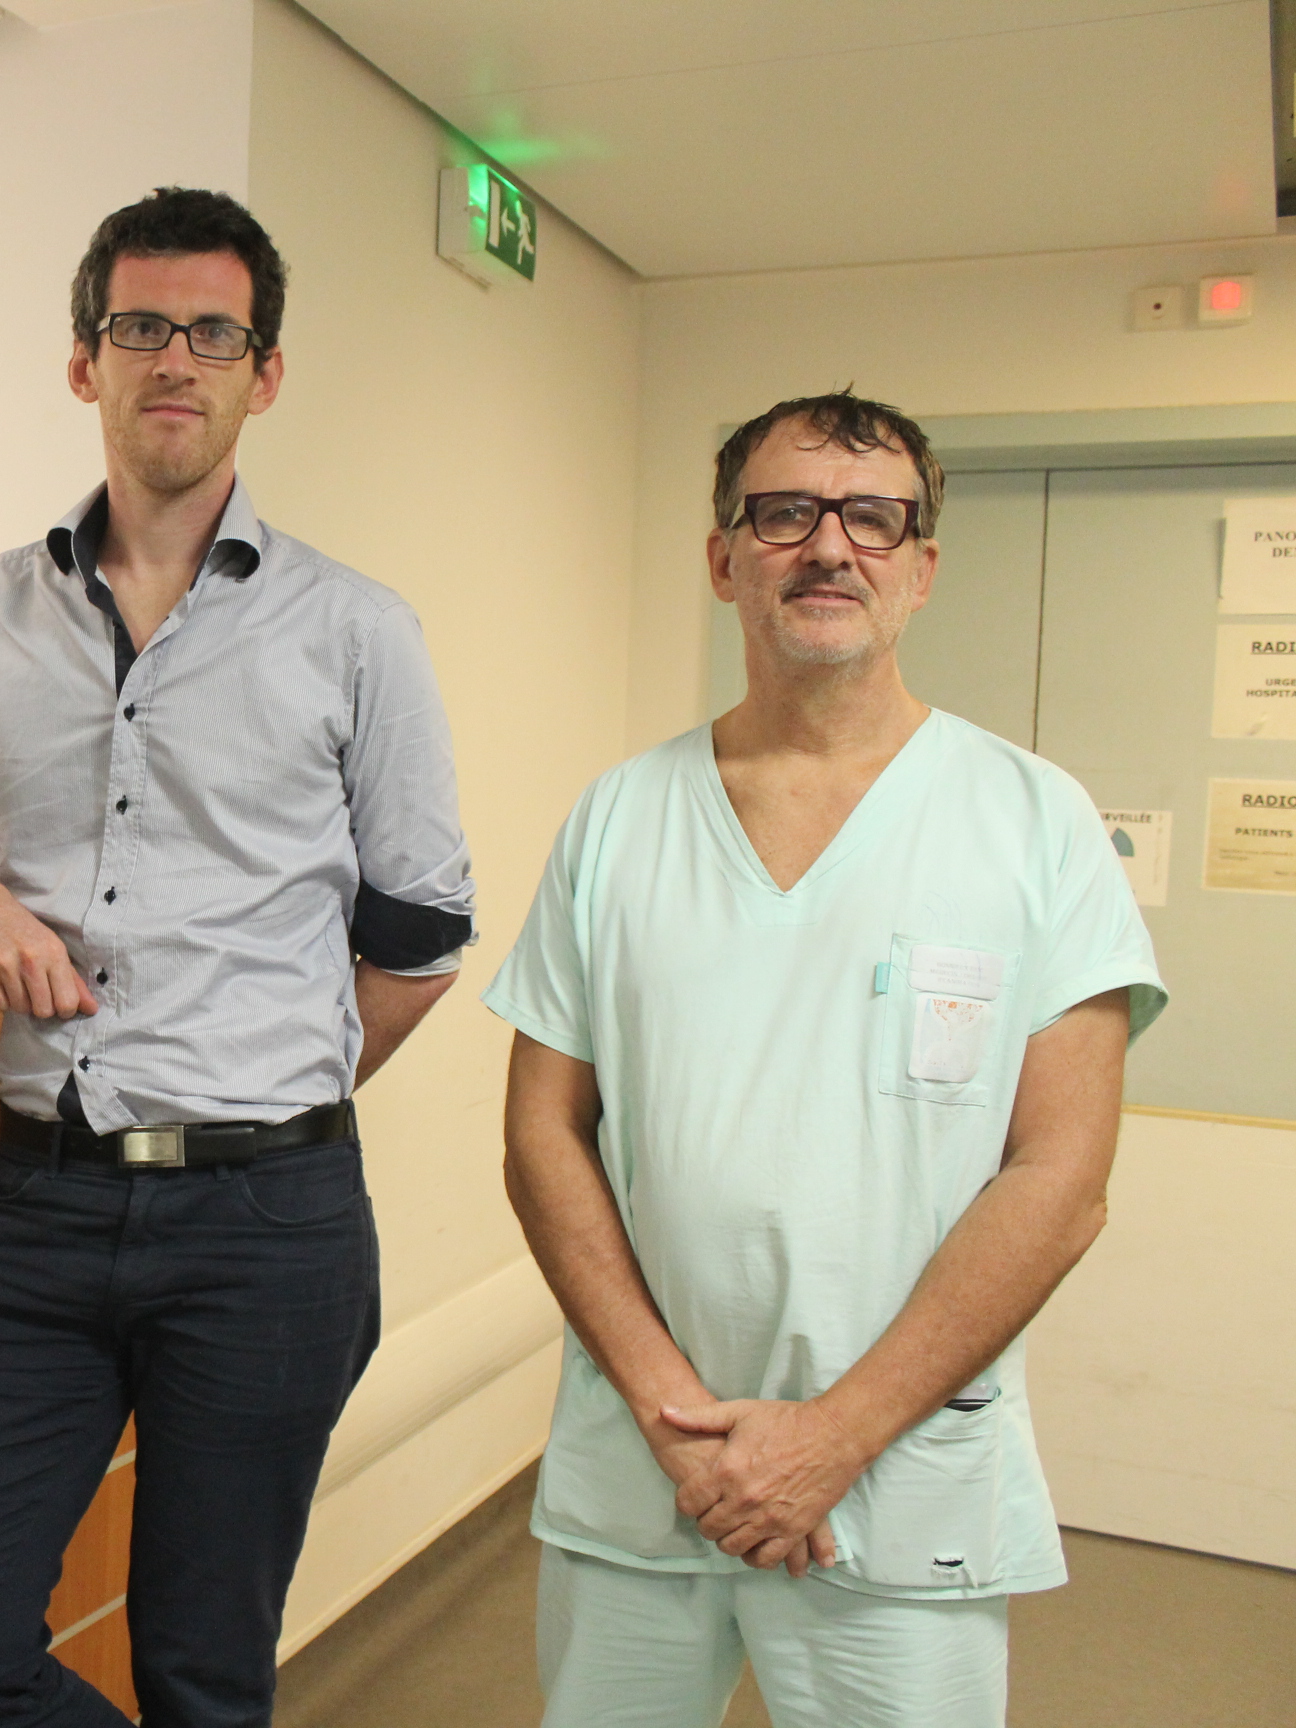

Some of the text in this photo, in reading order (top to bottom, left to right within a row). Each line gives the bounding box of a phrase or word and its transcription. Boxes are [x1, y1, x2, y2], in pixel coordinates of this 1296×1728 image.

[1254, 530, 1296, 542] PANO
[1272, 547, 1296, 558] DE
[1251, 641, 1296, 654] RADI
[1234, 827, 1294, 838] PATIENTS
